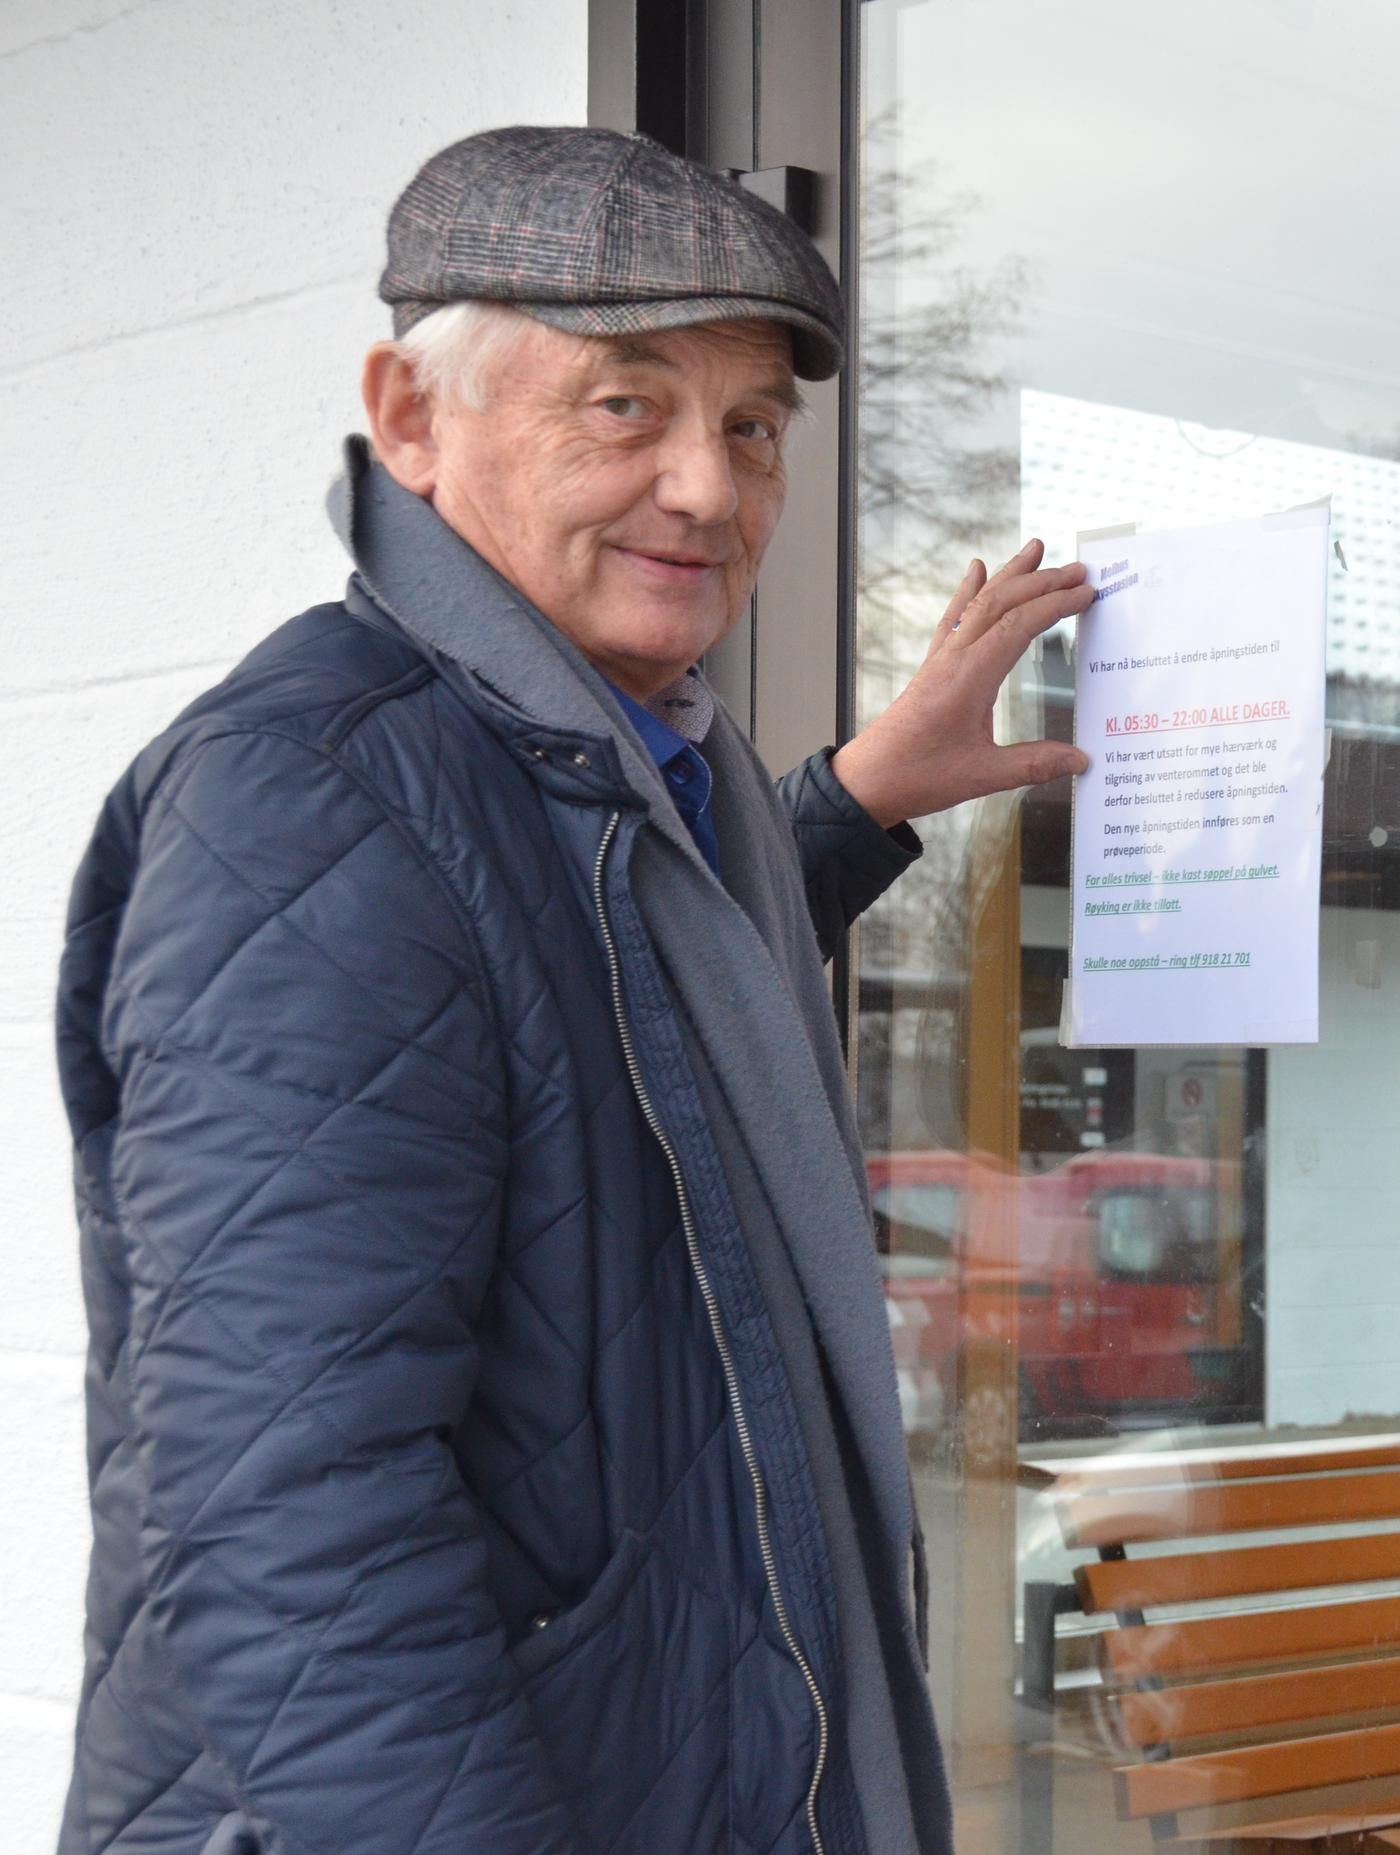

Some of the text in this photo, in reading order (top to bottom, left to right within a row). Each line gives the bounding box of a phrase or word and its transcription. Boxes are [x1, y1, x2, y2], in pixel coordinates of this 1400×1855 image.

[1094, 573, 1138, 601] kysstasjon
[1089, 639, 1280, 673] Vi har nå besluttet å endre åpningstiden til
[1125, 713, 1159, 731] 05:30
[1172, 709, 1207, 726] 22:00
[1210, 705, 1239, 722] ALLE
[1243, 700, 1291, 719] DAGER.
[1105, 752, 1114, 763] Vi
[1116, 751, 1131, 762] har
[1133, 750, 1154, 760] vært
[1157, 748, 1183, 759] utsatt
[1185, 745, 1198, 756] for
[1201, 745, 1220, 757] mye
[1265, 739, 1277, 751] og
[1105, 760, 1267, 787] tilgrising av venterommet og det ble
[1104, 782, 1288, 807] derfor besluttet å redusere åpningstiden.
[1104, 814, 1274, 836] Den nye åpningstiden innføres som en
[1104, 842, 1166, 859] prøveperiode.
[1102, 872, 1122, 885] alles
[1124, 870, 1152, 884] trivsel
[1162, 869, 1180, 880] ikke
[1182, 868, 1202, 880] kast
[1203, 865, 1234, 881] søppel
[1235, 864, 1246, 878] på
[1248, 864, 1280, 879] gulvet.
[1084, 900, 1120, 914] Røyking
[1121, 902, 1132, 911] er
[1133, 899, 1152, 911] ikke
[1083, 956, 1108, 969] Skulle
[1110, 959, 1126, 968] noe
[1128, 954, 1160, 969] oppstå
[1168, 954, 1188, 968] ring
[1190, 953, 1202, 968] tlf
[1202, 953, 1219, 966] 918
[1221, 953, 1232, 965] 21
[1234, 952, 1251, 964] 701
